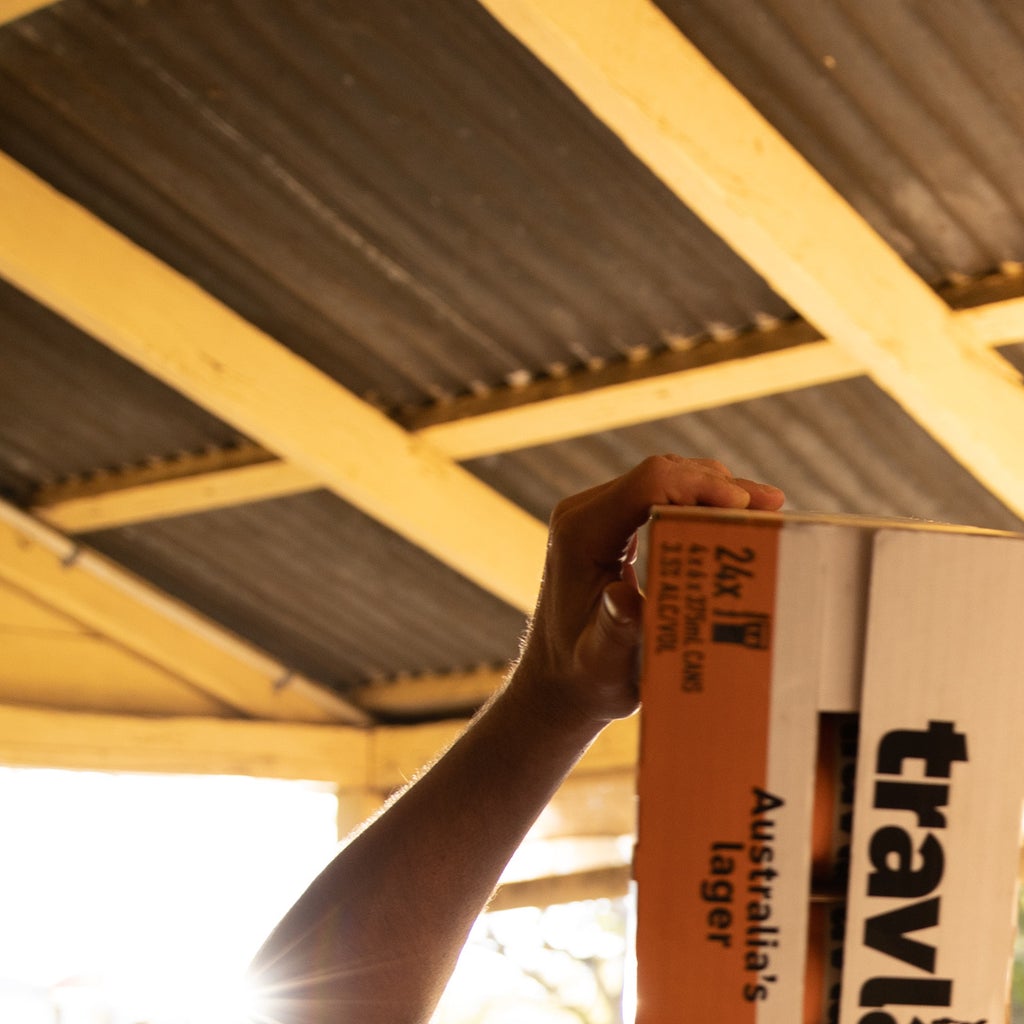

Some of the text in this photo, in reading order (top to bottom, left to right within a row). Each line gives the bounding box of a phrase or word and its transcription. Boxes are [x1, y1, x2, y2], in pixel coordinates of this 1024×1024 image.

[714, 546, 756, 599] 24x
[681, 650, 705, 694] CANS
[700, 840, 744, 949] lager
[742, 787, 785, 1003] Australia's
